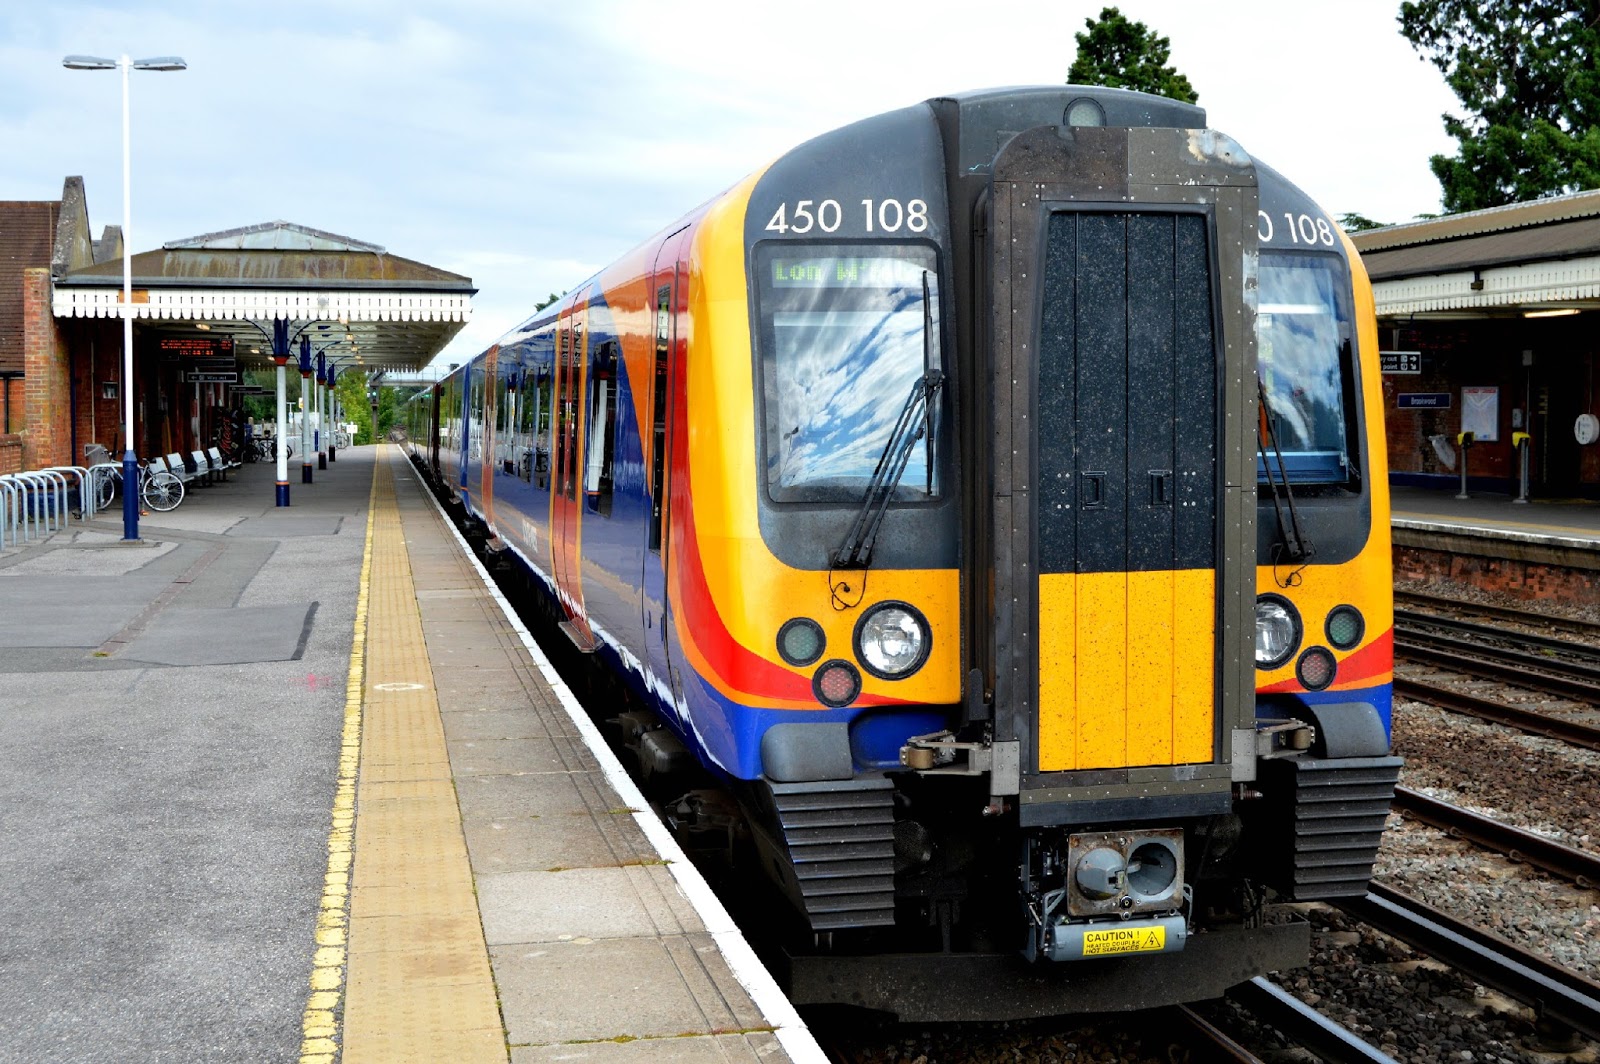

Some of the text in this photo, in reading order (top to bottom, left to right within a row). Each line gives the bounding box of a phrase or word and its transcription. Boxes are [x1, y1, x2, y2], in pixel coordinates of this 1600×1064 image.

[765, 198, 928, 234] 450 108
[1284, 212, 1335, 247] 108
[776, 259, 822, 281] Lon
[1383, 363, 1398, 371] point
[1411, 396, 1437, 405] Brookwood
[1086, 930, 1133, 943] CAUTION
[1085, 945, 1140, 955] HOT SURFACES
